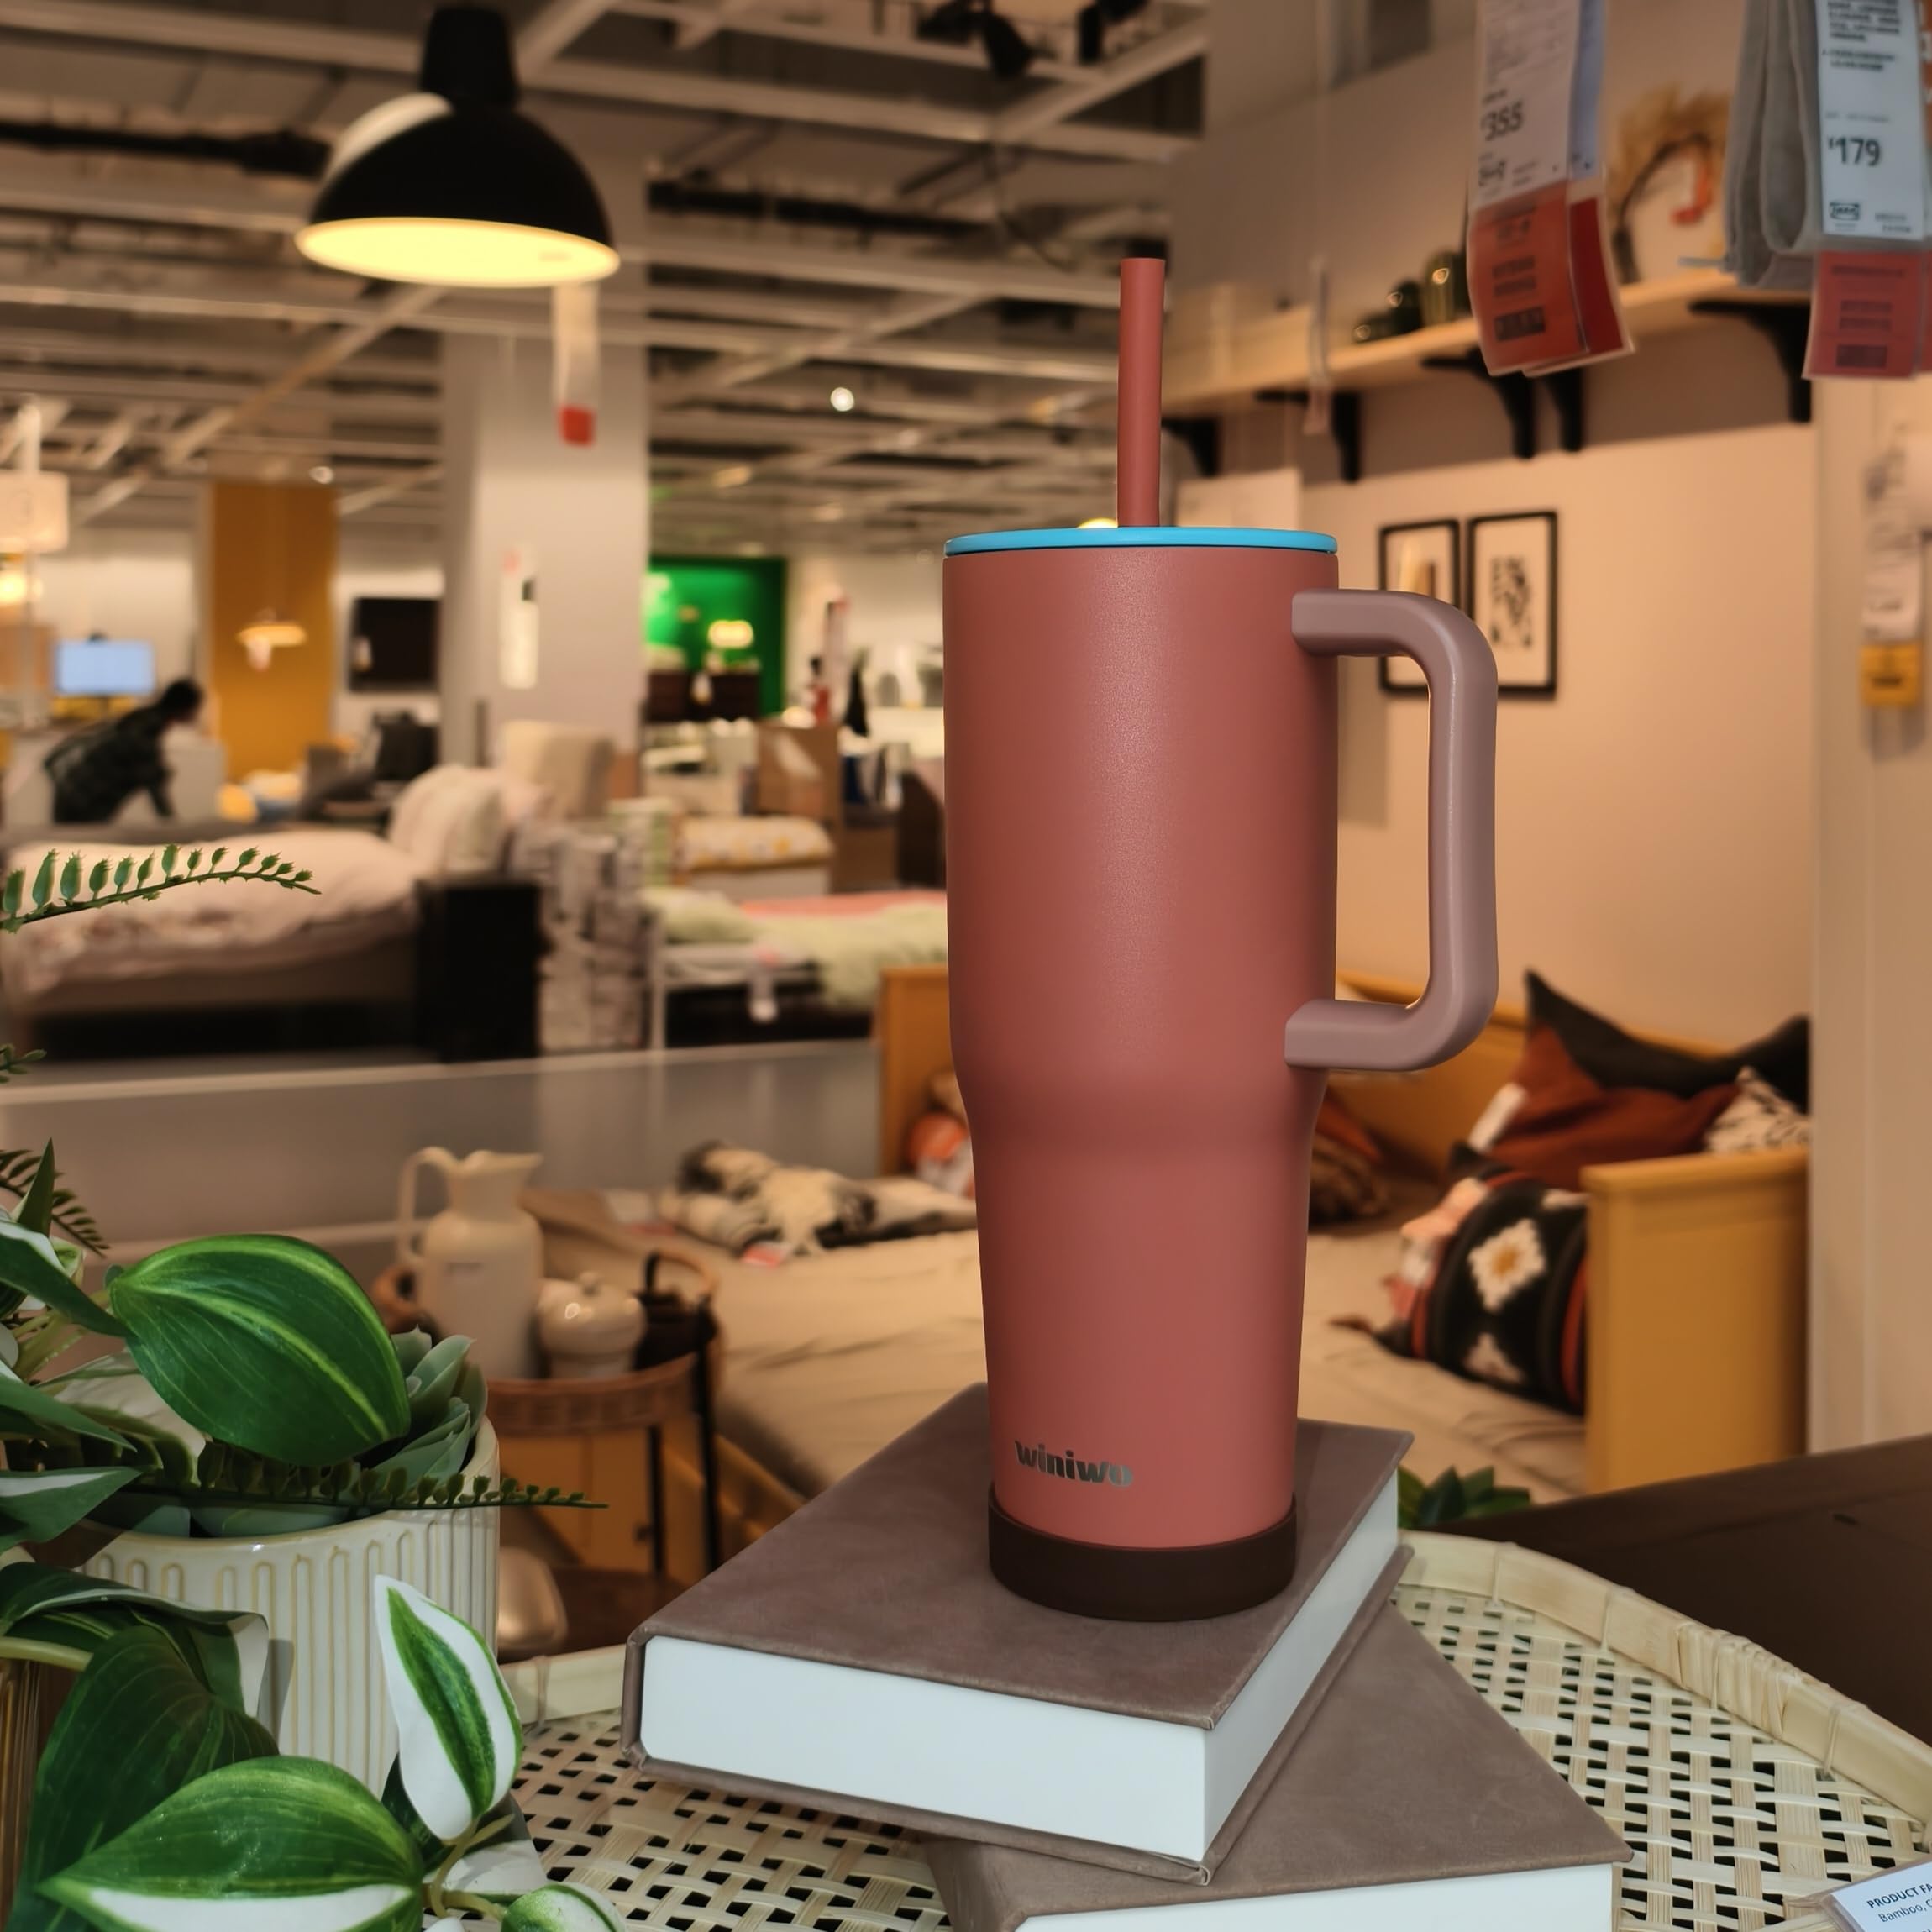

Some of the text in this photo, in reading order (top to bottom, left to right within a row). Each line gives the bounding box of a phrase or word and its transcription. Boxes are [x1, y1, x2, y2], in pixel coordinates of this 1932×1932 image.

[1014, 1439, 1133, 1488] winiwo
[1866, 1887, 1919, 1909] PRODUCT
[1877, 1904, 1927, 1923] Bamboo,
